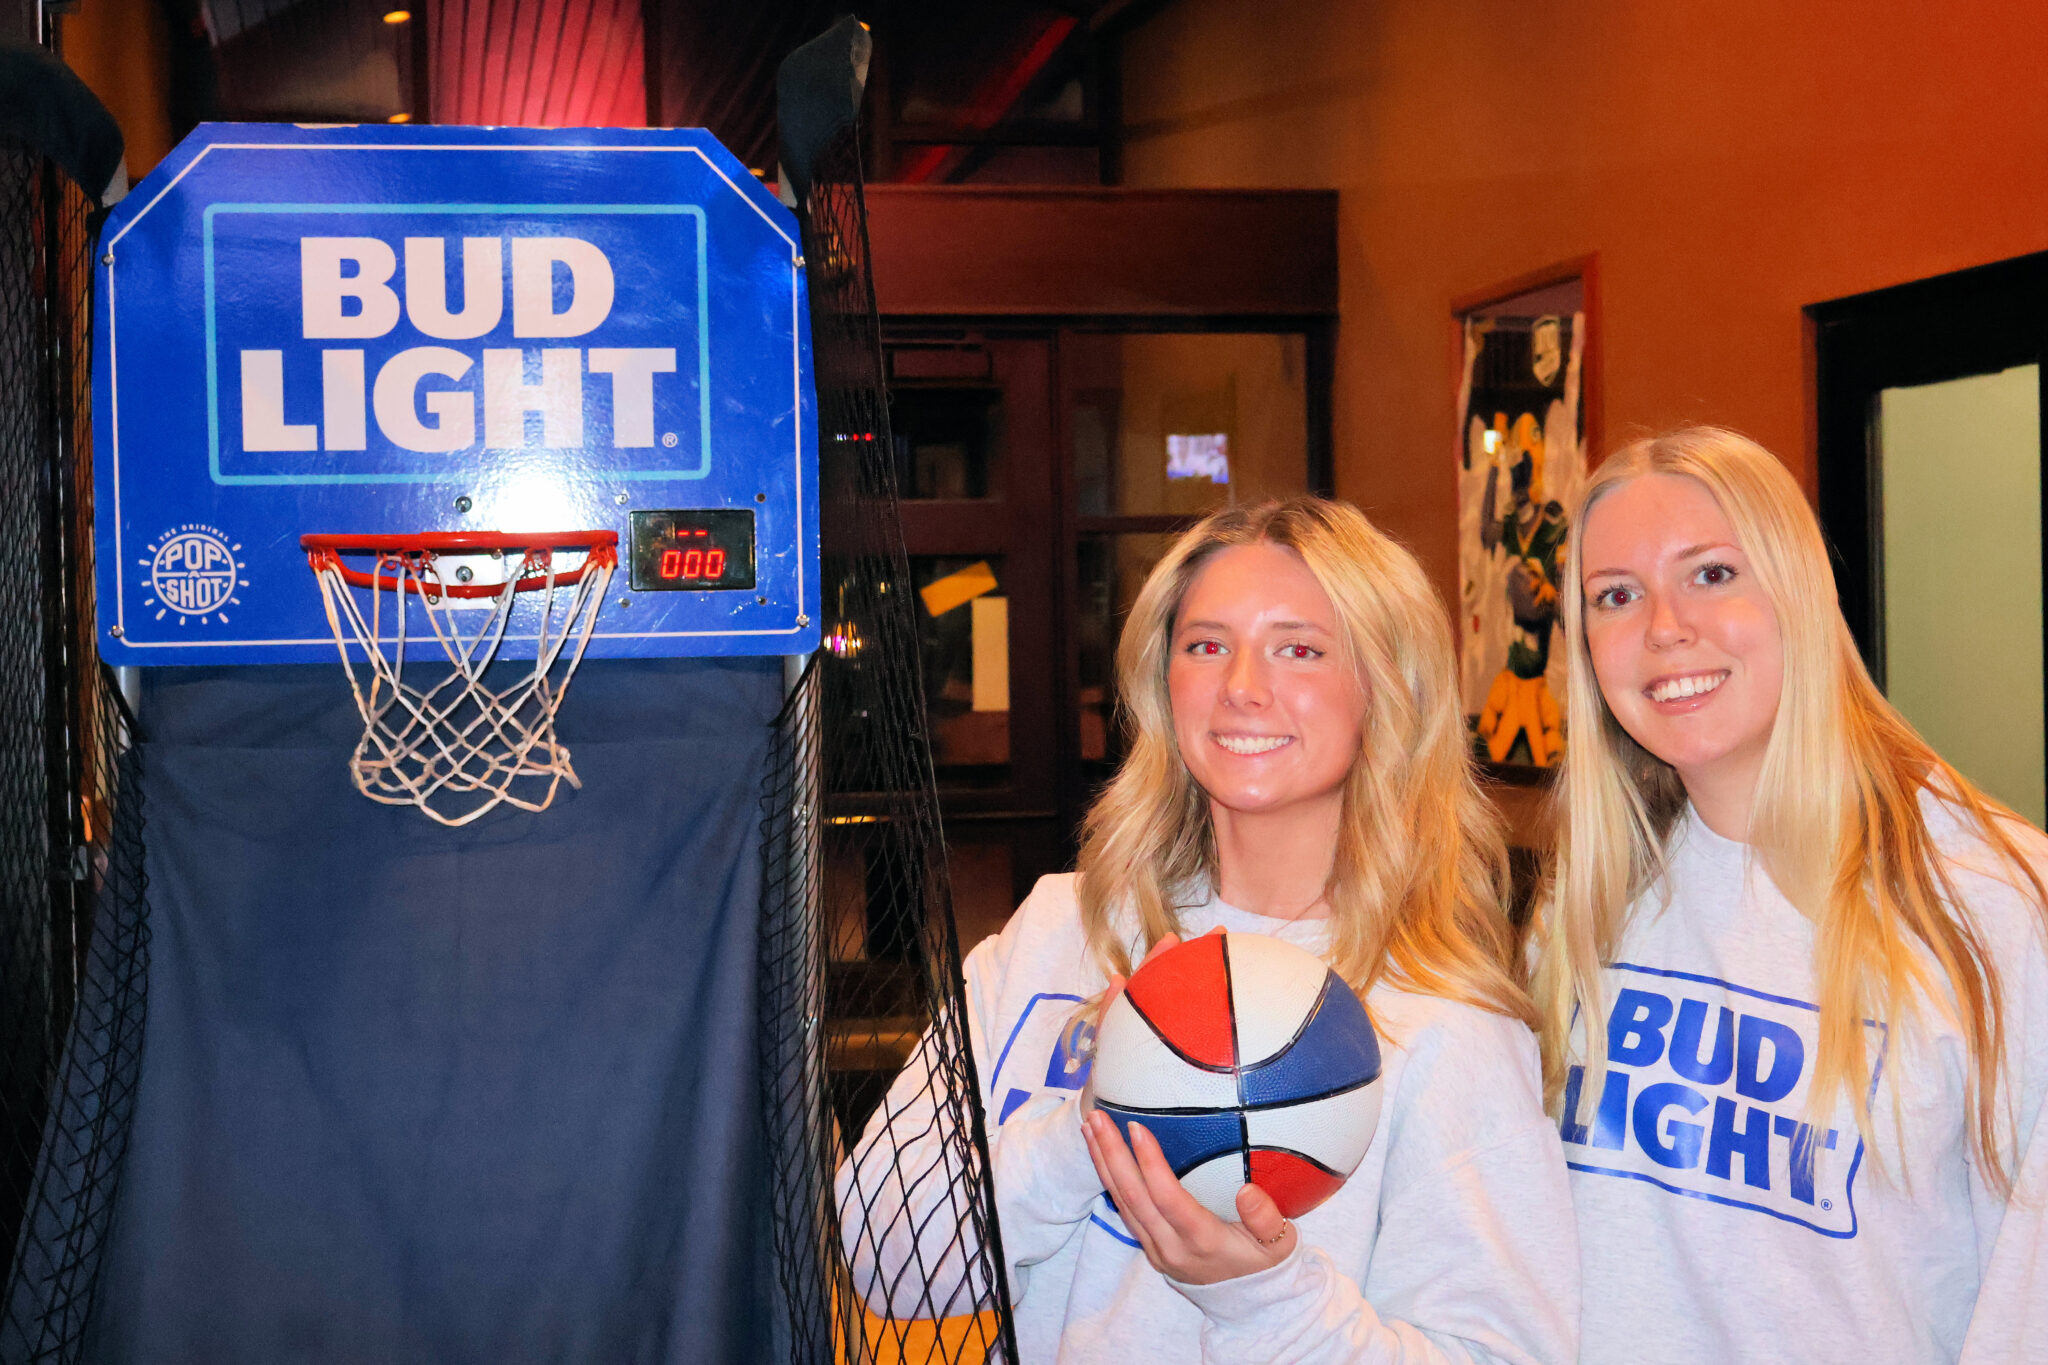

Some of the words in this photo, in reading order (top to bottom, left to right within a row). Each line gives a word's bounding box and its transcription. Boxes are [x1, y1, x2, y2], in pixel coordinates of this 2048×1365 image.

[300, 236, 615, 340] BUD
[240, 346, 677, 453] LIGHT
[165, 539, 222, 570] POP
[166, 578, 222, 608] SHOT
[661, 549, 725, 579] 000
[1607, 987, 1805, 1103] BUD
[1560, 1064, 1839, 1207] LIGHT
